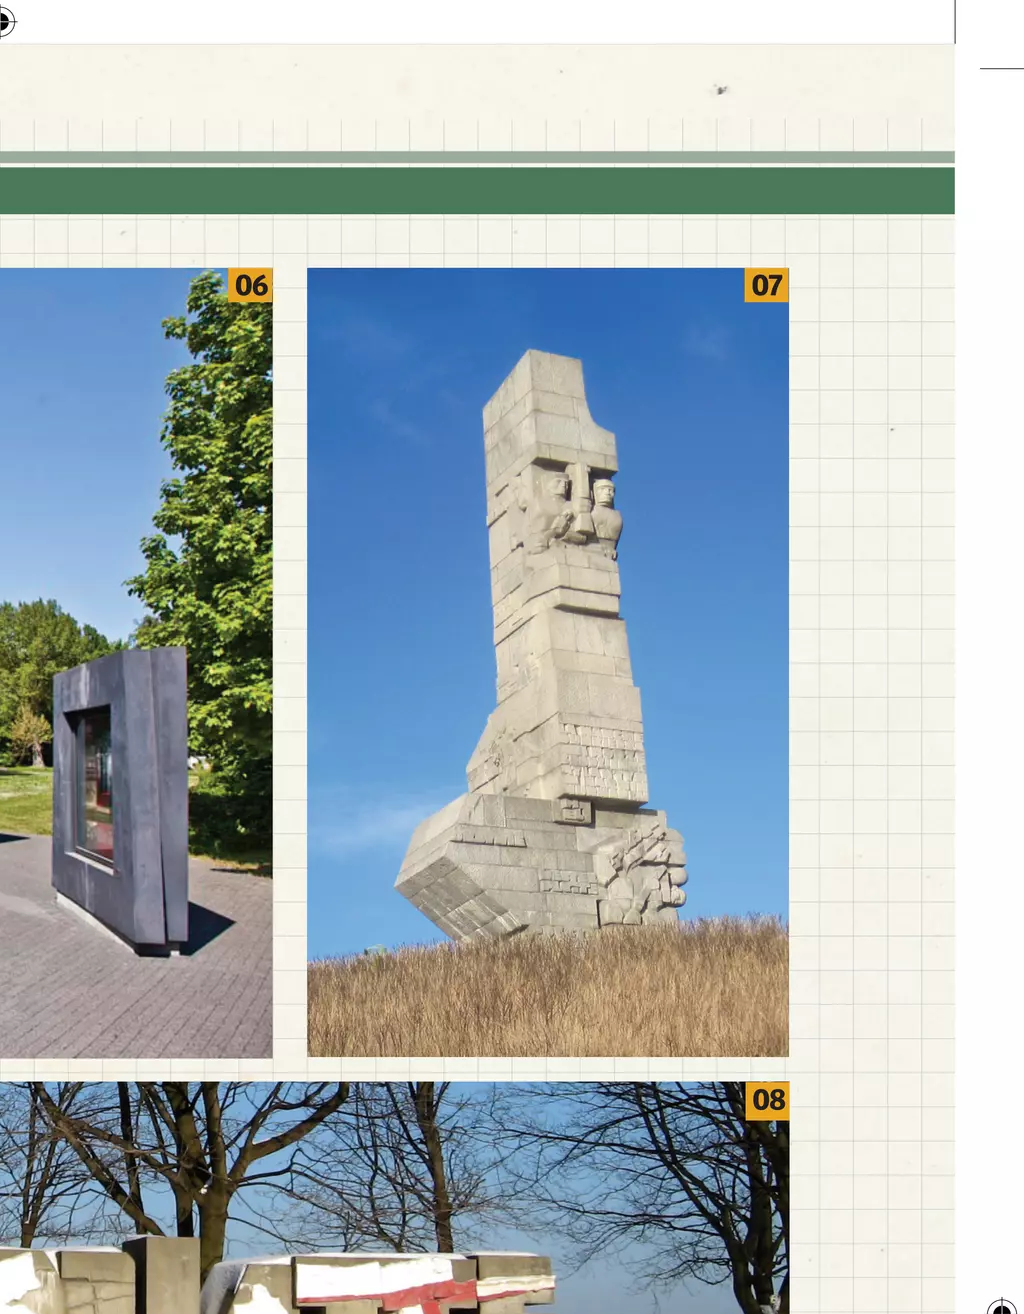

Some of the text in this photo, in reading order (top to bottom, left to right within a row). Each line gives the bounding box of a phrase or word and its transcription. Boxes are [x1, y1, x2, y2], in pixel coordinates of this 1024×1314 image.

[236, 274, 268, 296] 06
[752, 274, 782, 296] 07
[753, 1089, 785, 1110] 08
